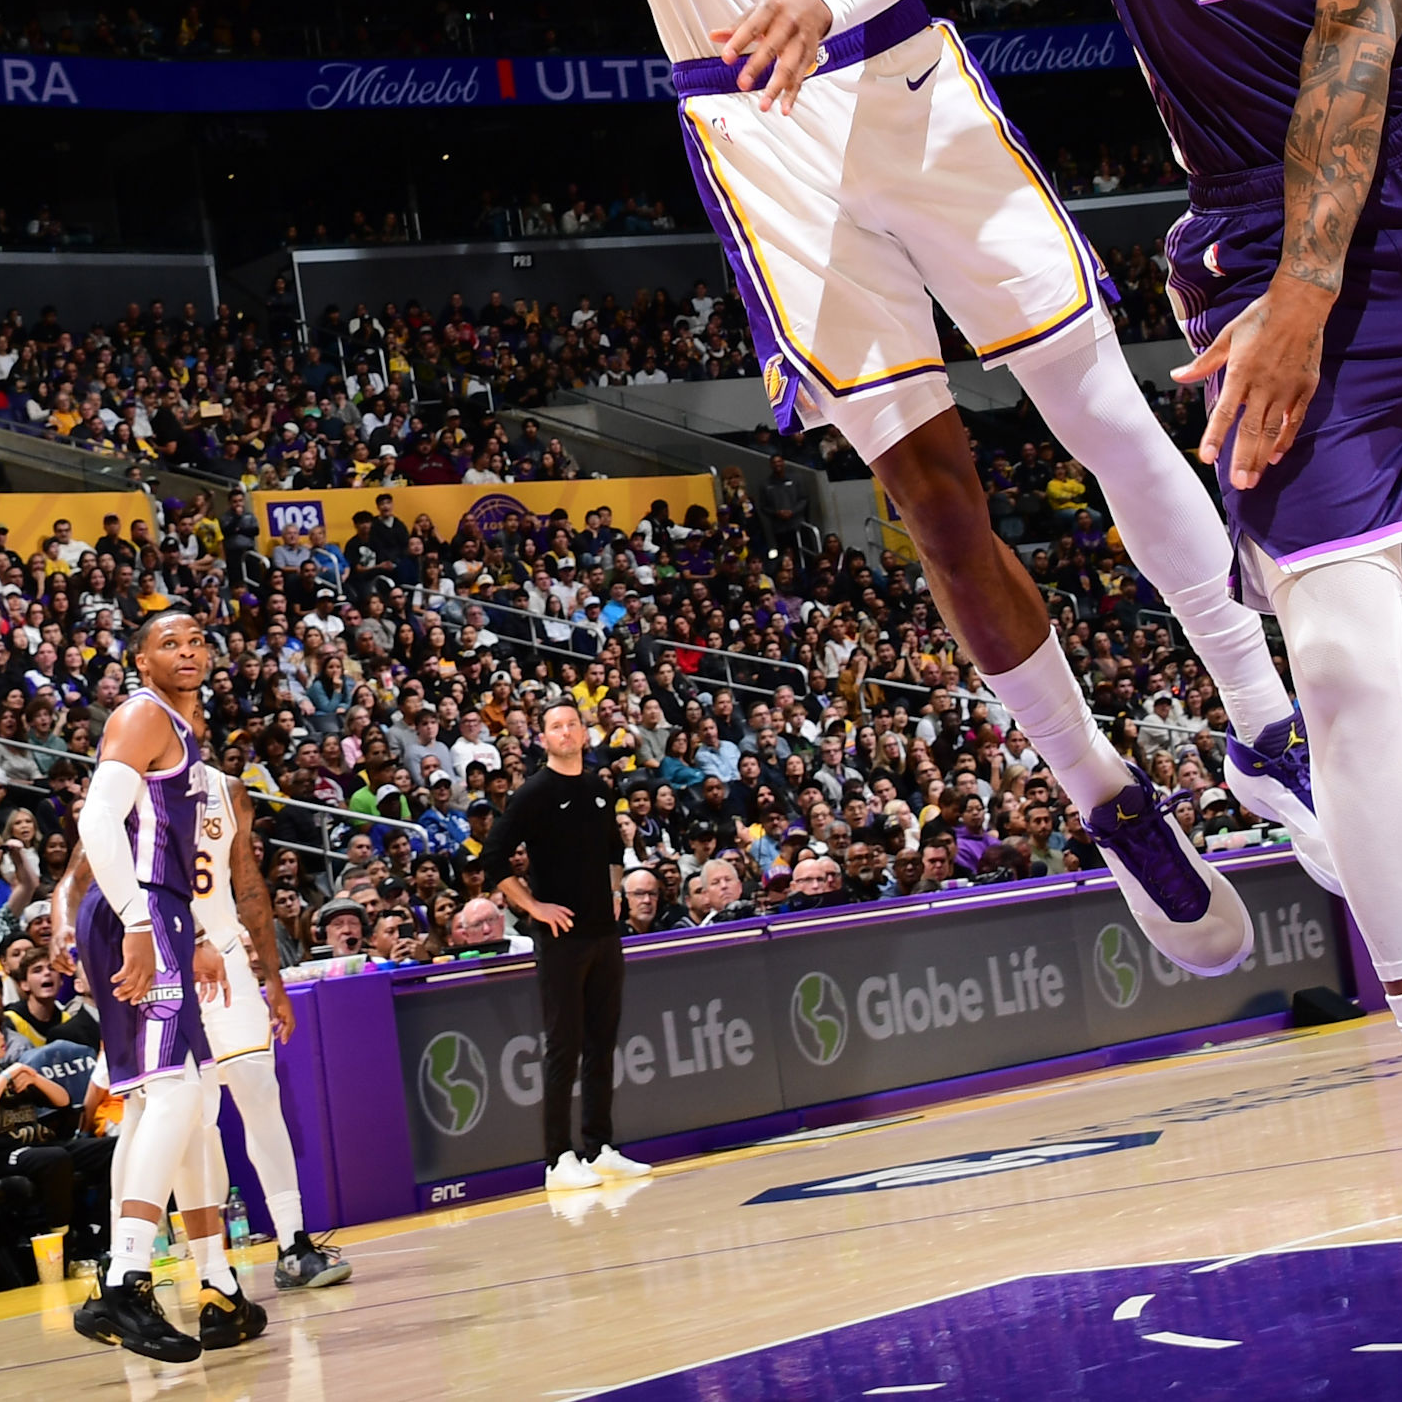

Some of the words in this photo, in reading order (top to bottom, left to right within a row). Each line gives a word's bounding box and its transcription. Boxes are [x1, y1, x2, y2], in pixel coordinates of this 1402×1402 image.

[968, 29, 1117, 76] Michelob
[307, 61, 479, 110] Michelob
[535, 58, 676, 101] ULTR
[273, 505, 320, 535] 103
[1257, 902, 1326, 967] Life
[856, 968, 985, 1041] Globe
[993, 946, 1066, 1016] Life
[659, 997, 754, 1078] Life
[41, 1055, 98, 1081] DELTA
[431, 1181, 467, 1204] anc
